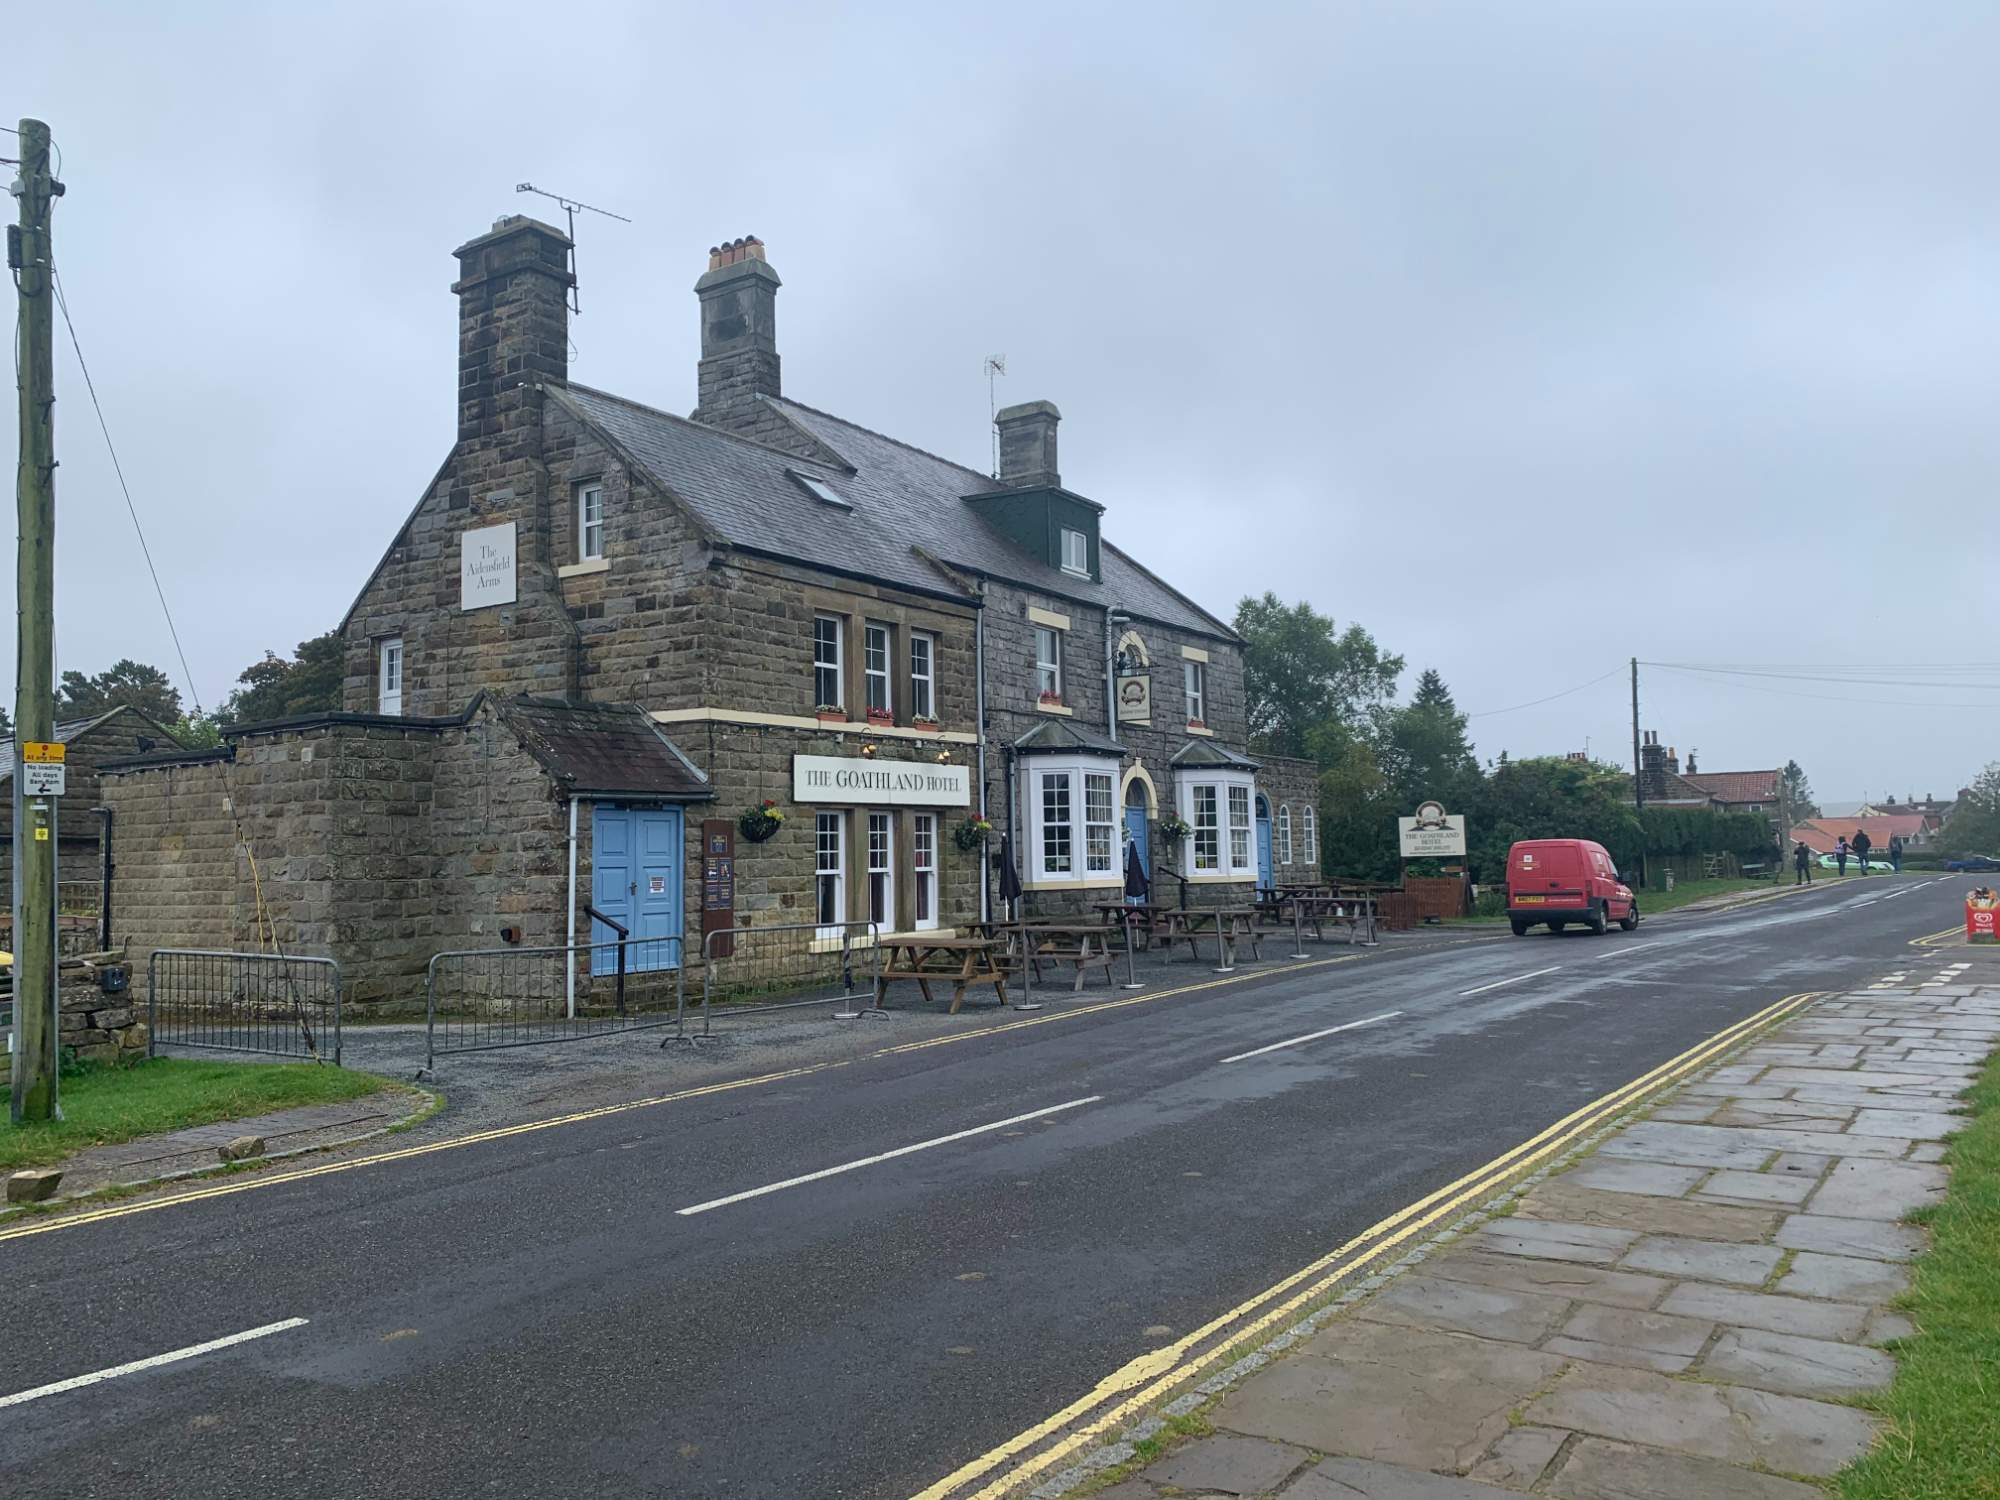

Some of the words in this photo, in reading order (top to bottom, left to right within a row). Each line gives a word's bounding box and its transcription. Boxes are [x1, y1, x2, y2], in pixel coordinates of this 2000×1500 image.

[480, 545, 497, 559] The
[477, 576, 502, 589] Arms
[806, 770, 832, 786] THE
[836, 769, 923, 791] GOATHLAND
[926, 776, 962, 792] HOTEL
